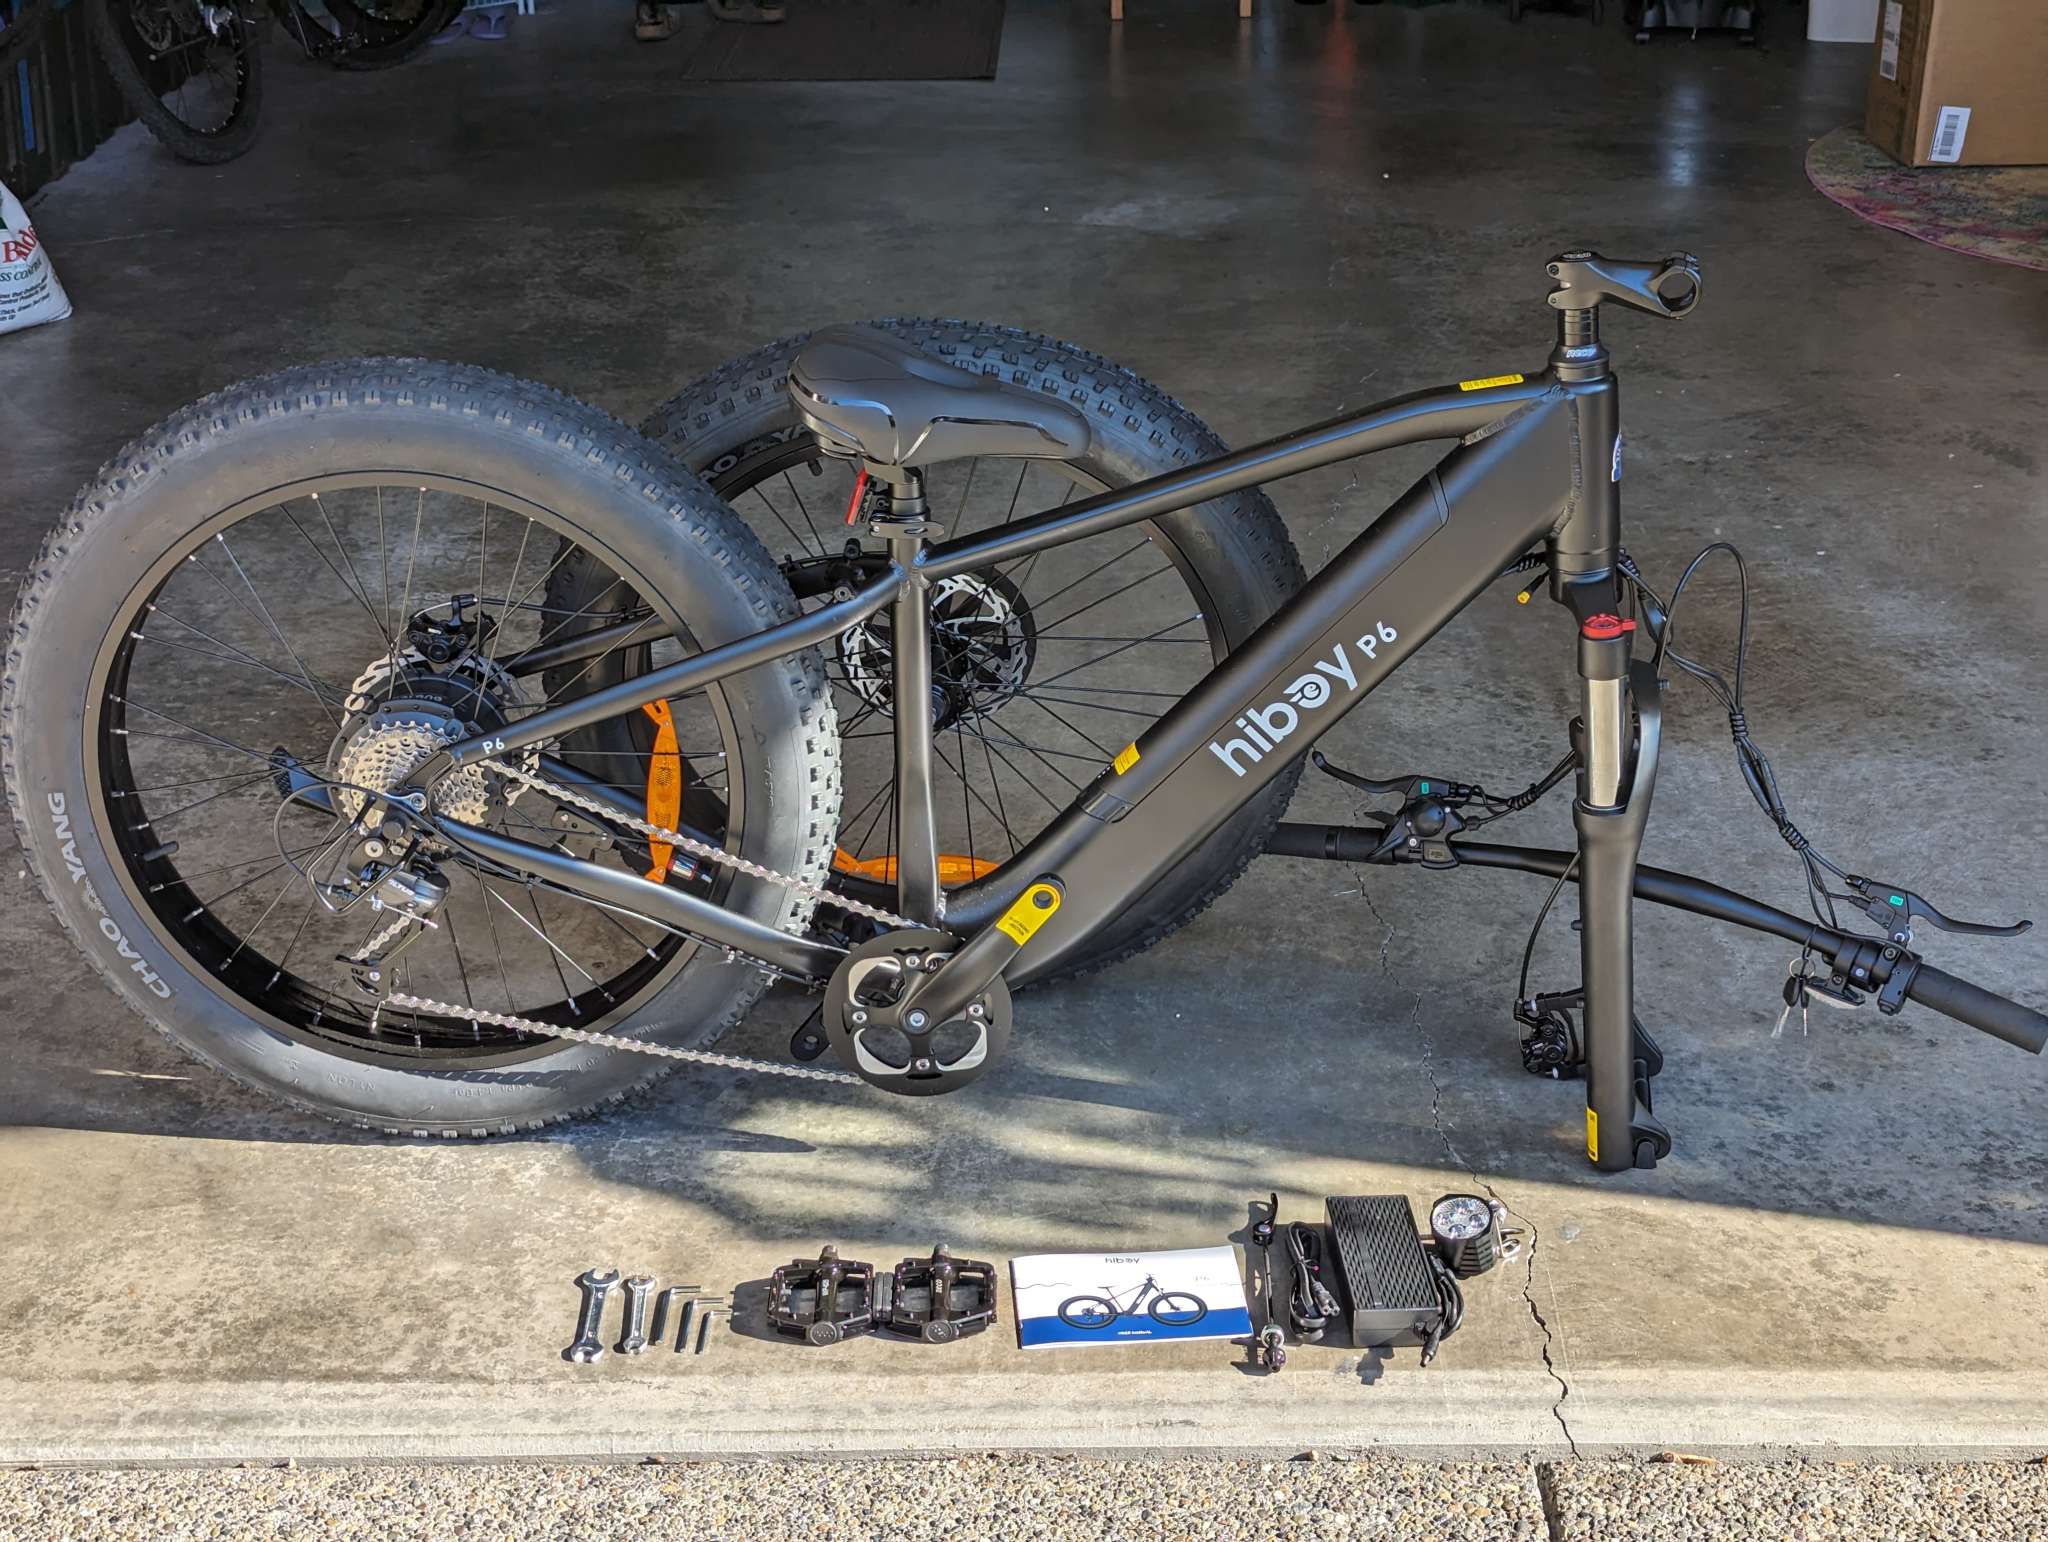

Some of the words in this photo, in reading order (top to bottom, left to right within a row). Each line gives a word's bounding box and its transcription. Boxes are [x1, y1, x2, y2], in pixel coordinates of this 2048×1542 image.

[1209, 643, 1358, 777] hiboy
[1355, 620, 1397, 660] P6
[482, 738, 505, 754] P6
[48, 792, 87, 884] YANG
[100, 917, 172, 999] CHAO
